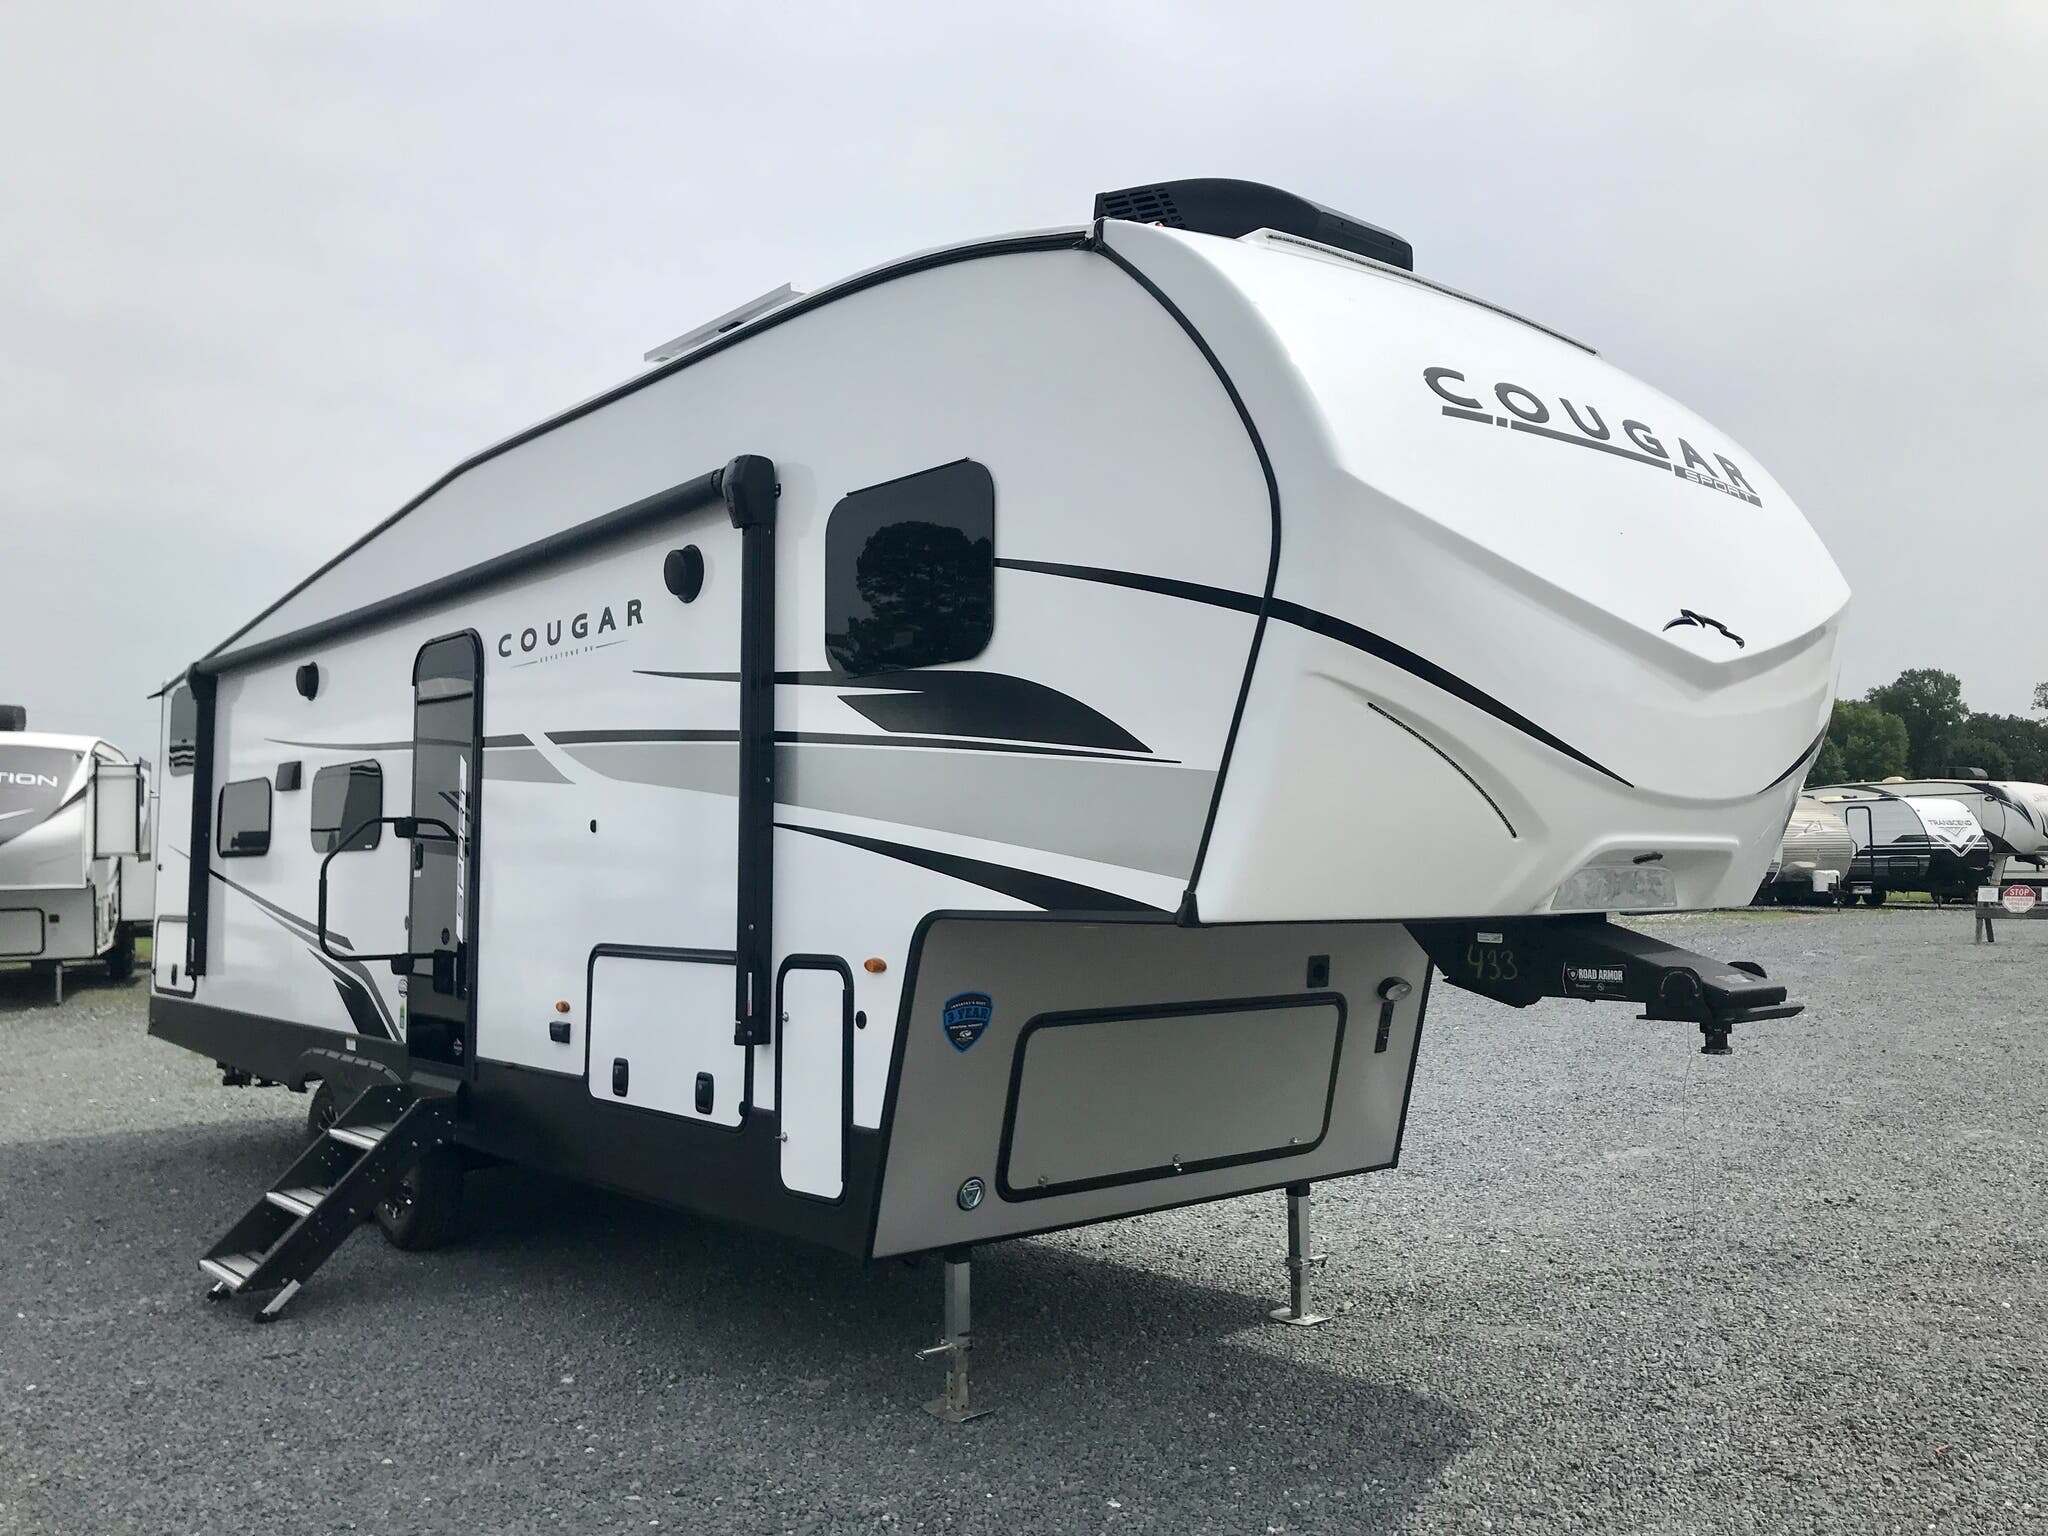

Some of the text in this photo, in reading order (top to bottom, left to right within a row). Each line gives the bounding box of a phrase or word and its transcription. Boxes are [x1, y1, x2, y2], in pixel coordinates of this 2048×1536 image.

[1423, 366, 1758, 495] COUGAR
[1685, 469, 1751, 502] SPORT
[498, 599, 643, 657] COUGAR
[2009, 888, 2030, 896] STOP
[1578, 968, 1623, 981] ROAD ARMOR
